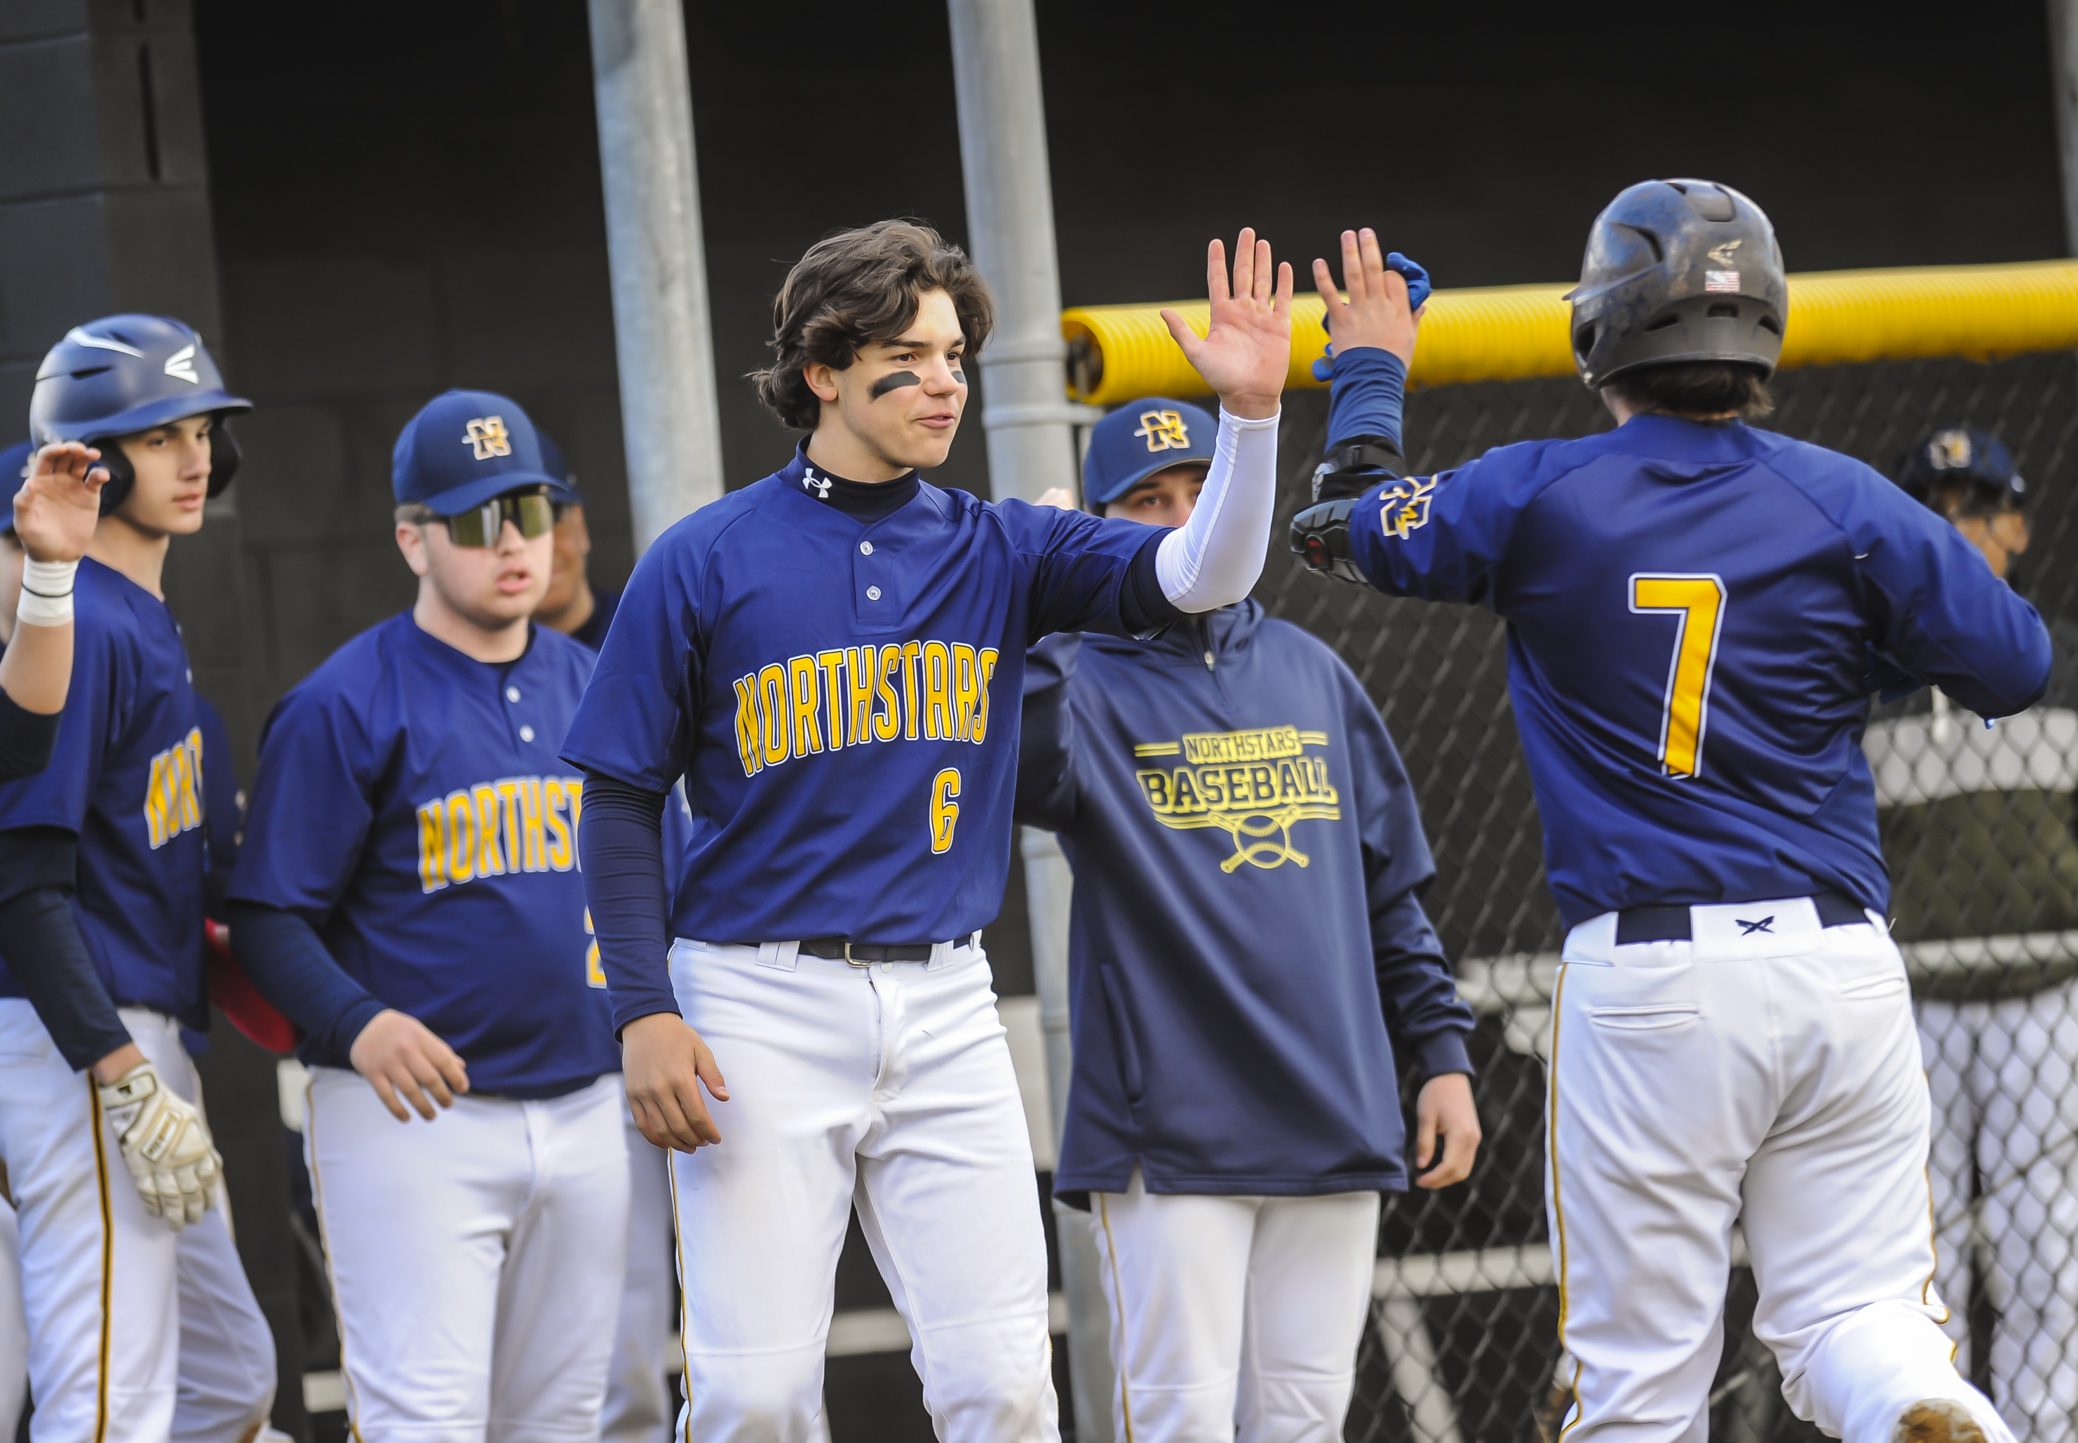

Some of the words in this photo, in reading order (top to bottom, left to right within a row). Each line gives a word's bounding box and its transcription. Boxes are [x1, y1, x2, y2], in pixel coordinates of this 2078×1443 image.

[733, 640, 999, 777] NORTHSTARS
[1628, 572, 1728, 780] 7
[1136, 757, 1339, 814] BASEBALL
[1182, 725, 1303, 764] NORTHSTARS
[929, 767, 961, 854] 6
